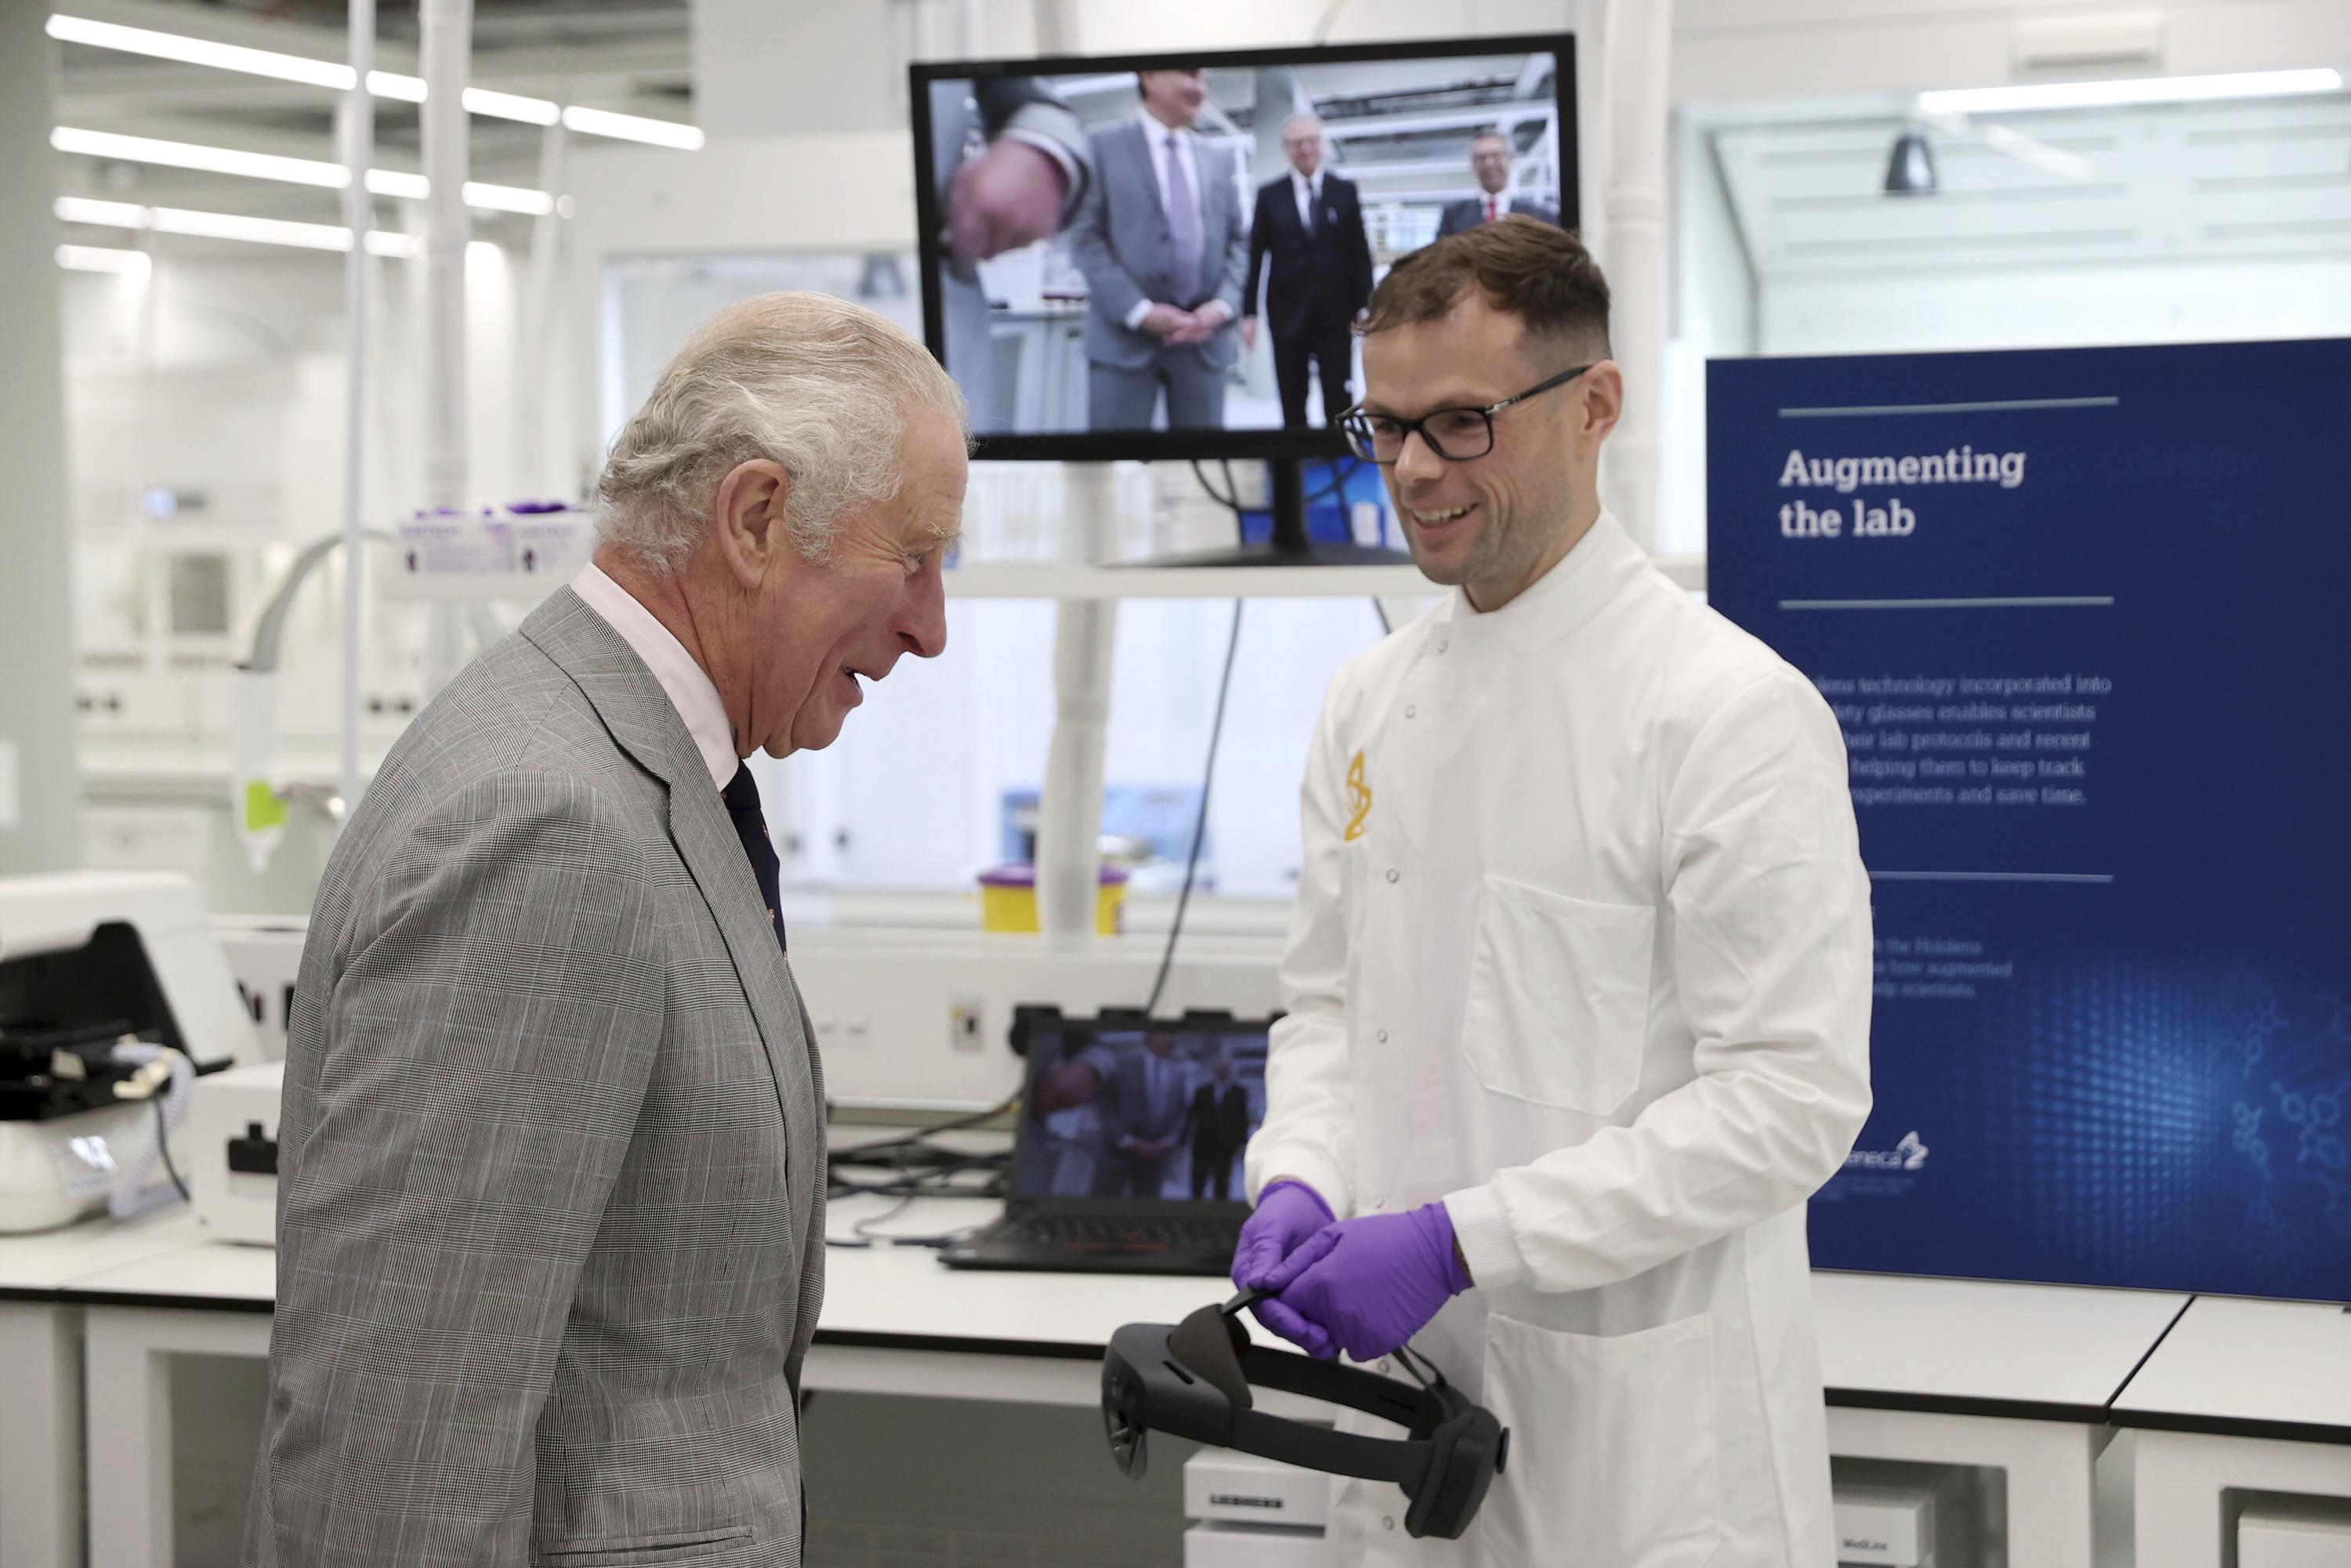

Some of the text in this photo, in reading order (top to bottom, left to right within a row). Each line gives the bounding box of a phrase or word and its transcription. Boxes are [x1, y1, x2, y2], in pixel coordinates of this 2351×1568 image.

[1779, 444, 2027, 493] Augmenting
[1780, 498, 1916, 538] the lab
[1815, 674, 2113, 698] lens technology incorporated into
[1867, 703, 1935, 726] glasses
[1936, 702, 2007, 722] enables
[2009, 702, 2096, 722] scientists
[1879, 730, 1909, 749] lab
[1911, 729, 1993, 753] protocols
[1996, 729, 2032, 749] and
[2035, 732, 2091, 750] recent
[1850, 756, 2085, 780] helping them to keep track
[1850, 784, 2086, 808] xperiments and save time.
[1844, 1150, 1902, 1169] eneca
